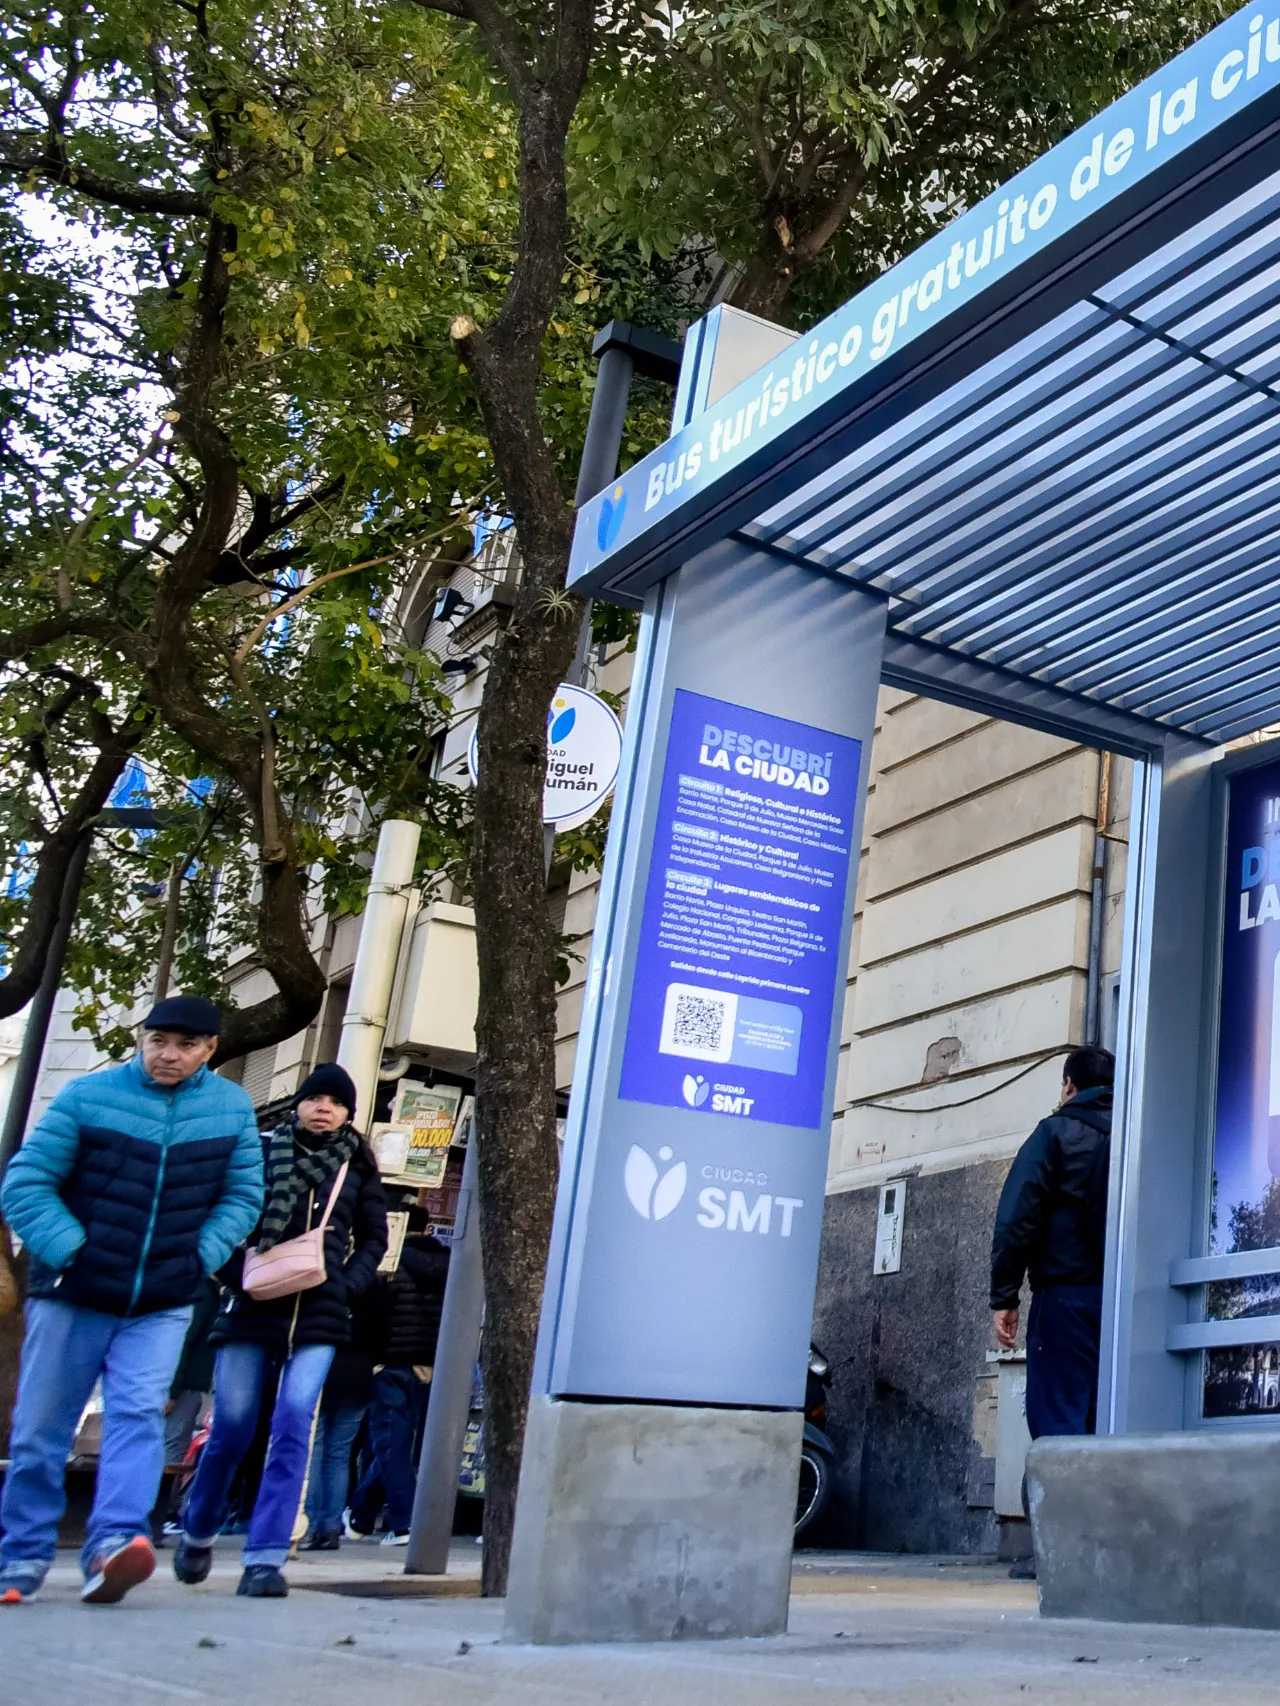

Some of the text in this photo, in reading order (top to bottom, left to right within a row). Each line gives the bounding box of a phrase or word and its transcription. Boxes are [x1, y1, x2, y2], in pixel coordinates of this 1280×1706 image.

[643, 448, 703, 513] Bus
[707, 322, 863, 454] turístico
[869, 181, 1057, 359] gratuito
[1068, 124, 1135, 203] de
[1146, 74, 1199, 155] la
[547, 749, 566, 757] DAD
[702, 724, 833, 778] DESCUBRÍ
[547, 758, 594, 777] iguel
[699, 745, 829, 796] LA CIUDAD
[546, 777, 598, 791] umán
[681, 776, 716, 792] Circuito
[765, 798, 799, 813] Cultural
[806, 808, 842, 824] Histórico
[675, 823, 709, 838] Circuito
[720, 834, 758, 850] Histórico
[765, 844, 799, 860] Cultural
[668, 870, 702, 885] Circuito
[714, 881, 748, 896] Lugares
[749, 891, 808, 909] emblemáticos
[676, 884, 707, 896] ciudad
[670, 960, 810, 995] Salidas desde calle Laprida primera cuadra
[714, 1082, 746, 1095] CIUDAD
[712, 1094, 754, 1116] SMT
[410, 1129, 450, 1147] 00.000
[701, 1165, 769, 1186] CIUDAD
[697, 1187, 803, 1237] SMT
